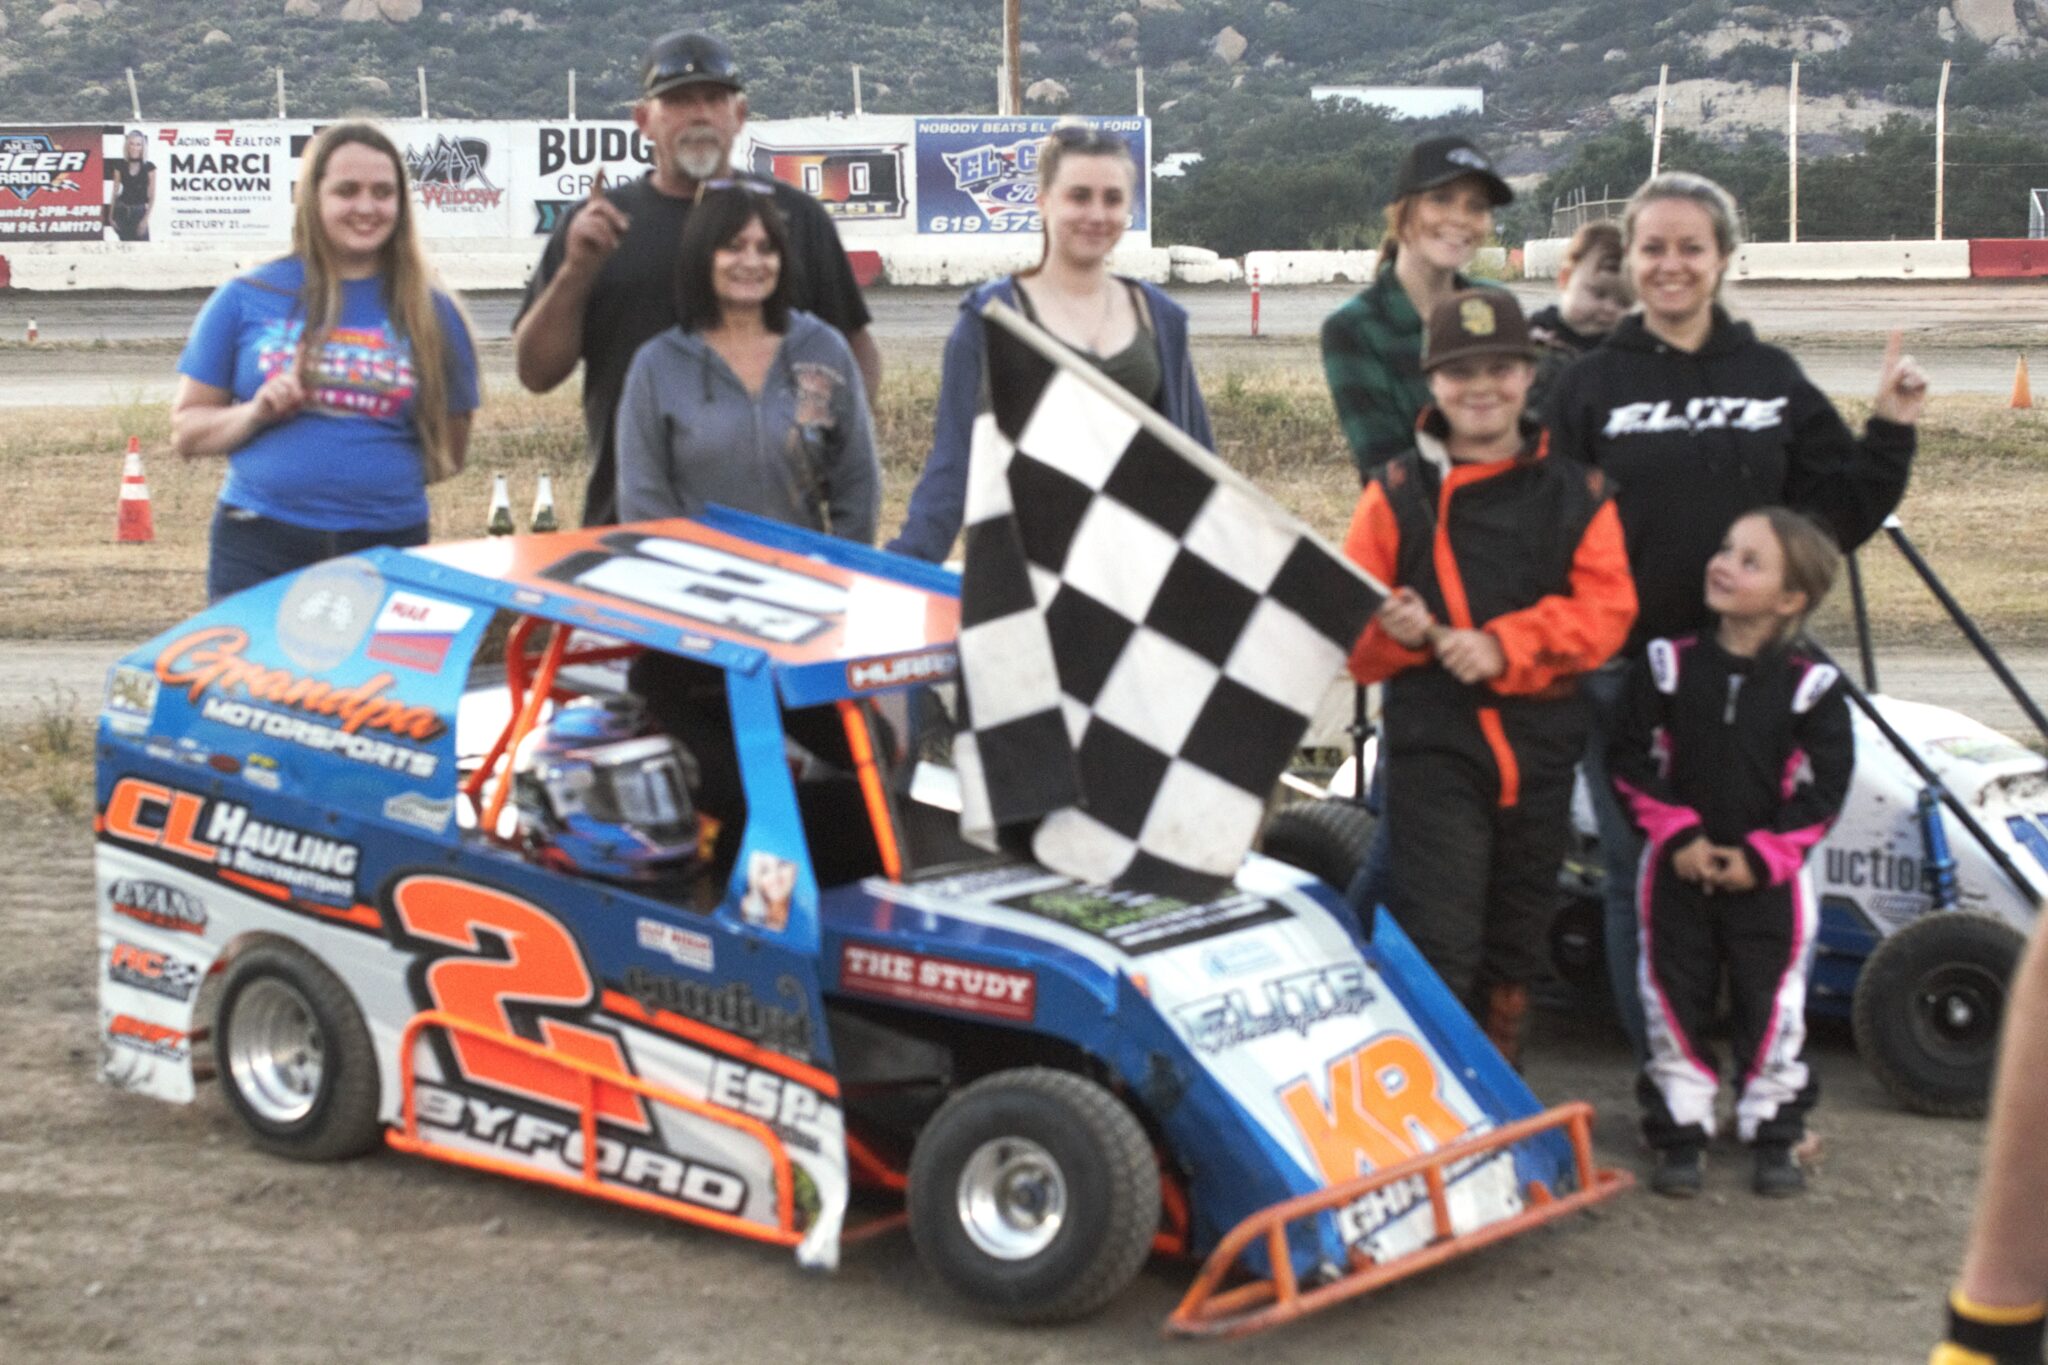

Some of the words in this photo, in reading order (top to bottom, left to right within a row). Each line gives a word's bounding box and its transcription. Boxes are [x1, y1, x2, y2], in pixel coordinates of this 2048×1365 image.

[919, 123, 978, 133] NOBODY
[982, 123, 1026, 133] BEATS
[1031, 123, 1047, 132] EL
[1103, 120, 1142, 131] FORD
[0, 152, 87, 171] ACER
[170, 154, 270, 174] MARCI
[539, 128, 656, 176] BUDG
[959, 153, 999, 183] EL
[170, 177, 270, 192] MCKOWN
[1005, 184, 1039, 202] Fo
[0, 206, 37, 219] unday
[170, 220, 225, 229] CENTURY
[930, 216, 981, 232] 619
[154, 626, 447, 741] Grandpa
[202, 697, 440, 779] MOTORSPORTS
[847, 947, 914, 983] THE
[918, 960, 1031, 1003] STUDY
[394, 873, 653, 1134] 2
[1275, 1028, 1470, 1190] KR
[411, 1083, 747, 1215] BYFORD
